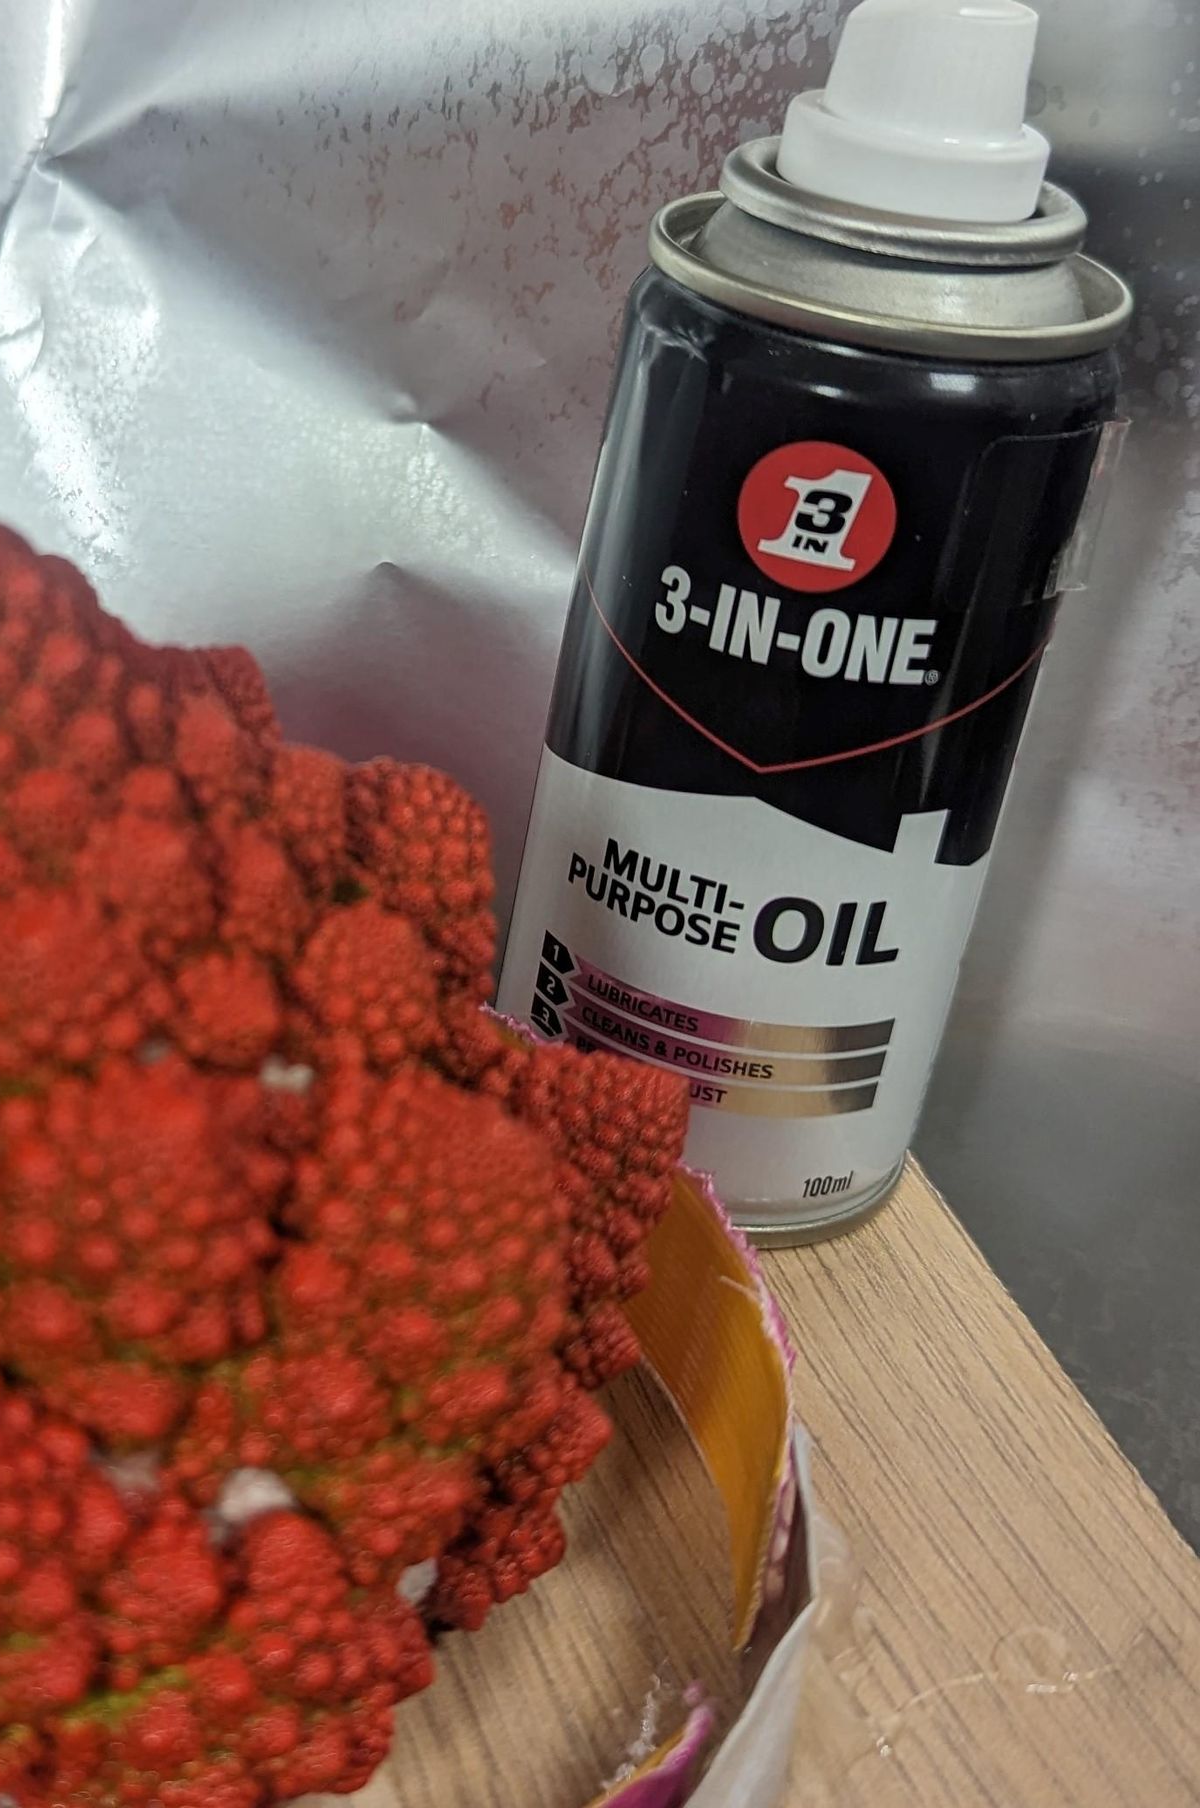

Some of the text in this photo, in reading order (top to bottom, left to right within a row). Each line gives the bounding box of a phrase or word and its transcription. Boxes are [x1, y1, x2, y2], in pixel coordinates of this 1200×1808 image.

[792, 536, 828, 554] IN
[795, 490, 852, 534] 3
[568, 852, 741, 954] PURPOSE
[602, 838, 745, 914] MULTI-
[753, 896, 900, 966] OIL
[553, 944, 699, 1032] 1 LUBRICATES
[541, 1007, 728, 1103] 3 UST
[547, 975, 556, 995] 2
[582, 1006, 649, 1051] CLEANS
[654, 1040, 668, 1060] &
[673, 1046, 774, 1080] POLISHES
[802, 1170, 854, 1198] 100ml
